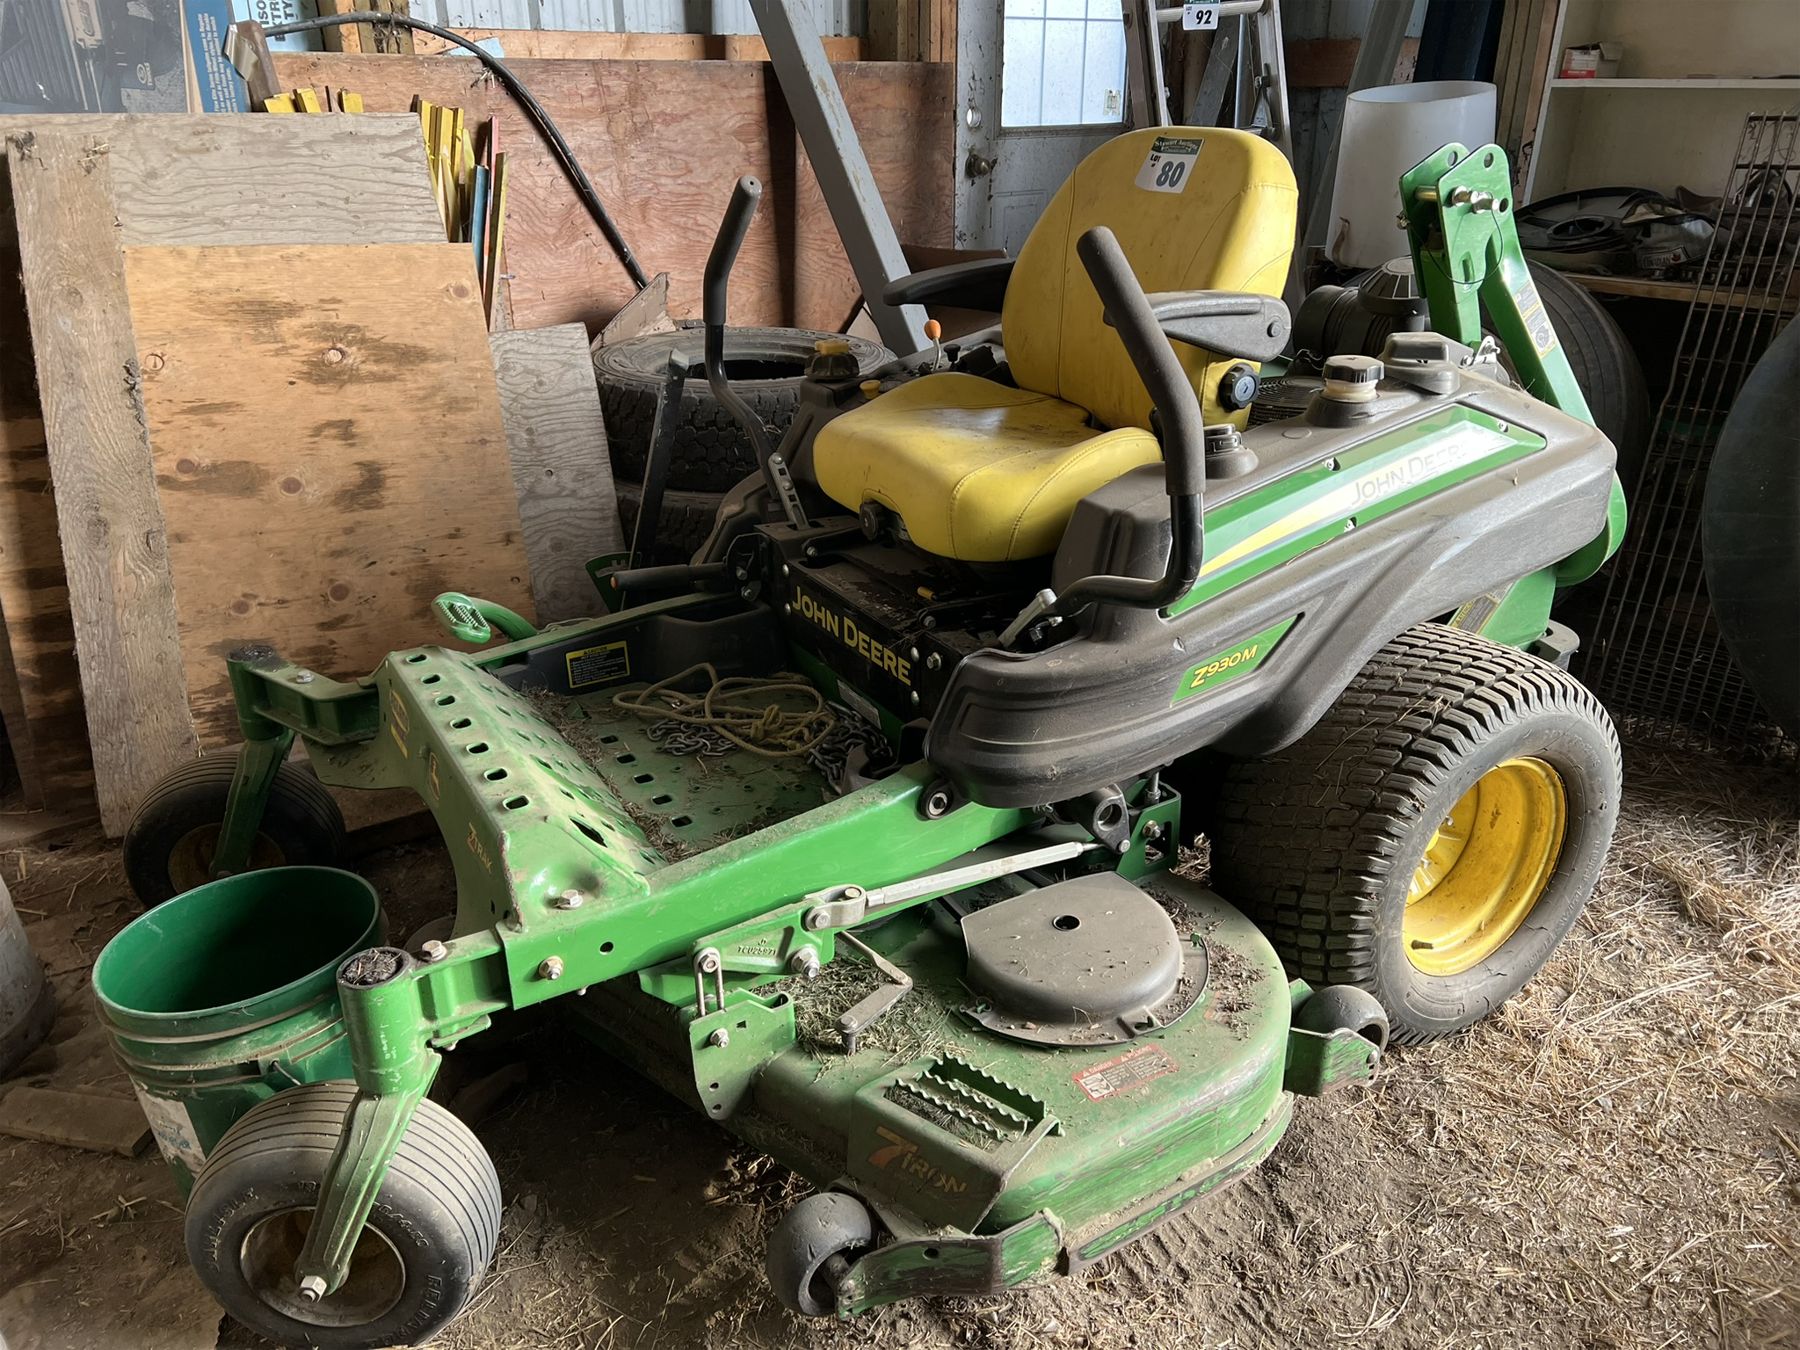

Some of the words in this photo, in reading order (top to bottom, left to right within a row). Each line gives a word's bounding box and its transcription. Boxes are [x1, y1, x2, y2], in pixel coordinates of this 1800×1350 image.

[1196, 10, 1212, 24] 92
[1156, 161, 1185, 188] 80
[1351, 465, 1404, 507] JOHN
[1407, 442, 1467, 480] DEER
[792, 585, 839, 638] JOHN
[843, 616, 912, 687] DEERE
[1190, 644, 1258, 689] Z930M
